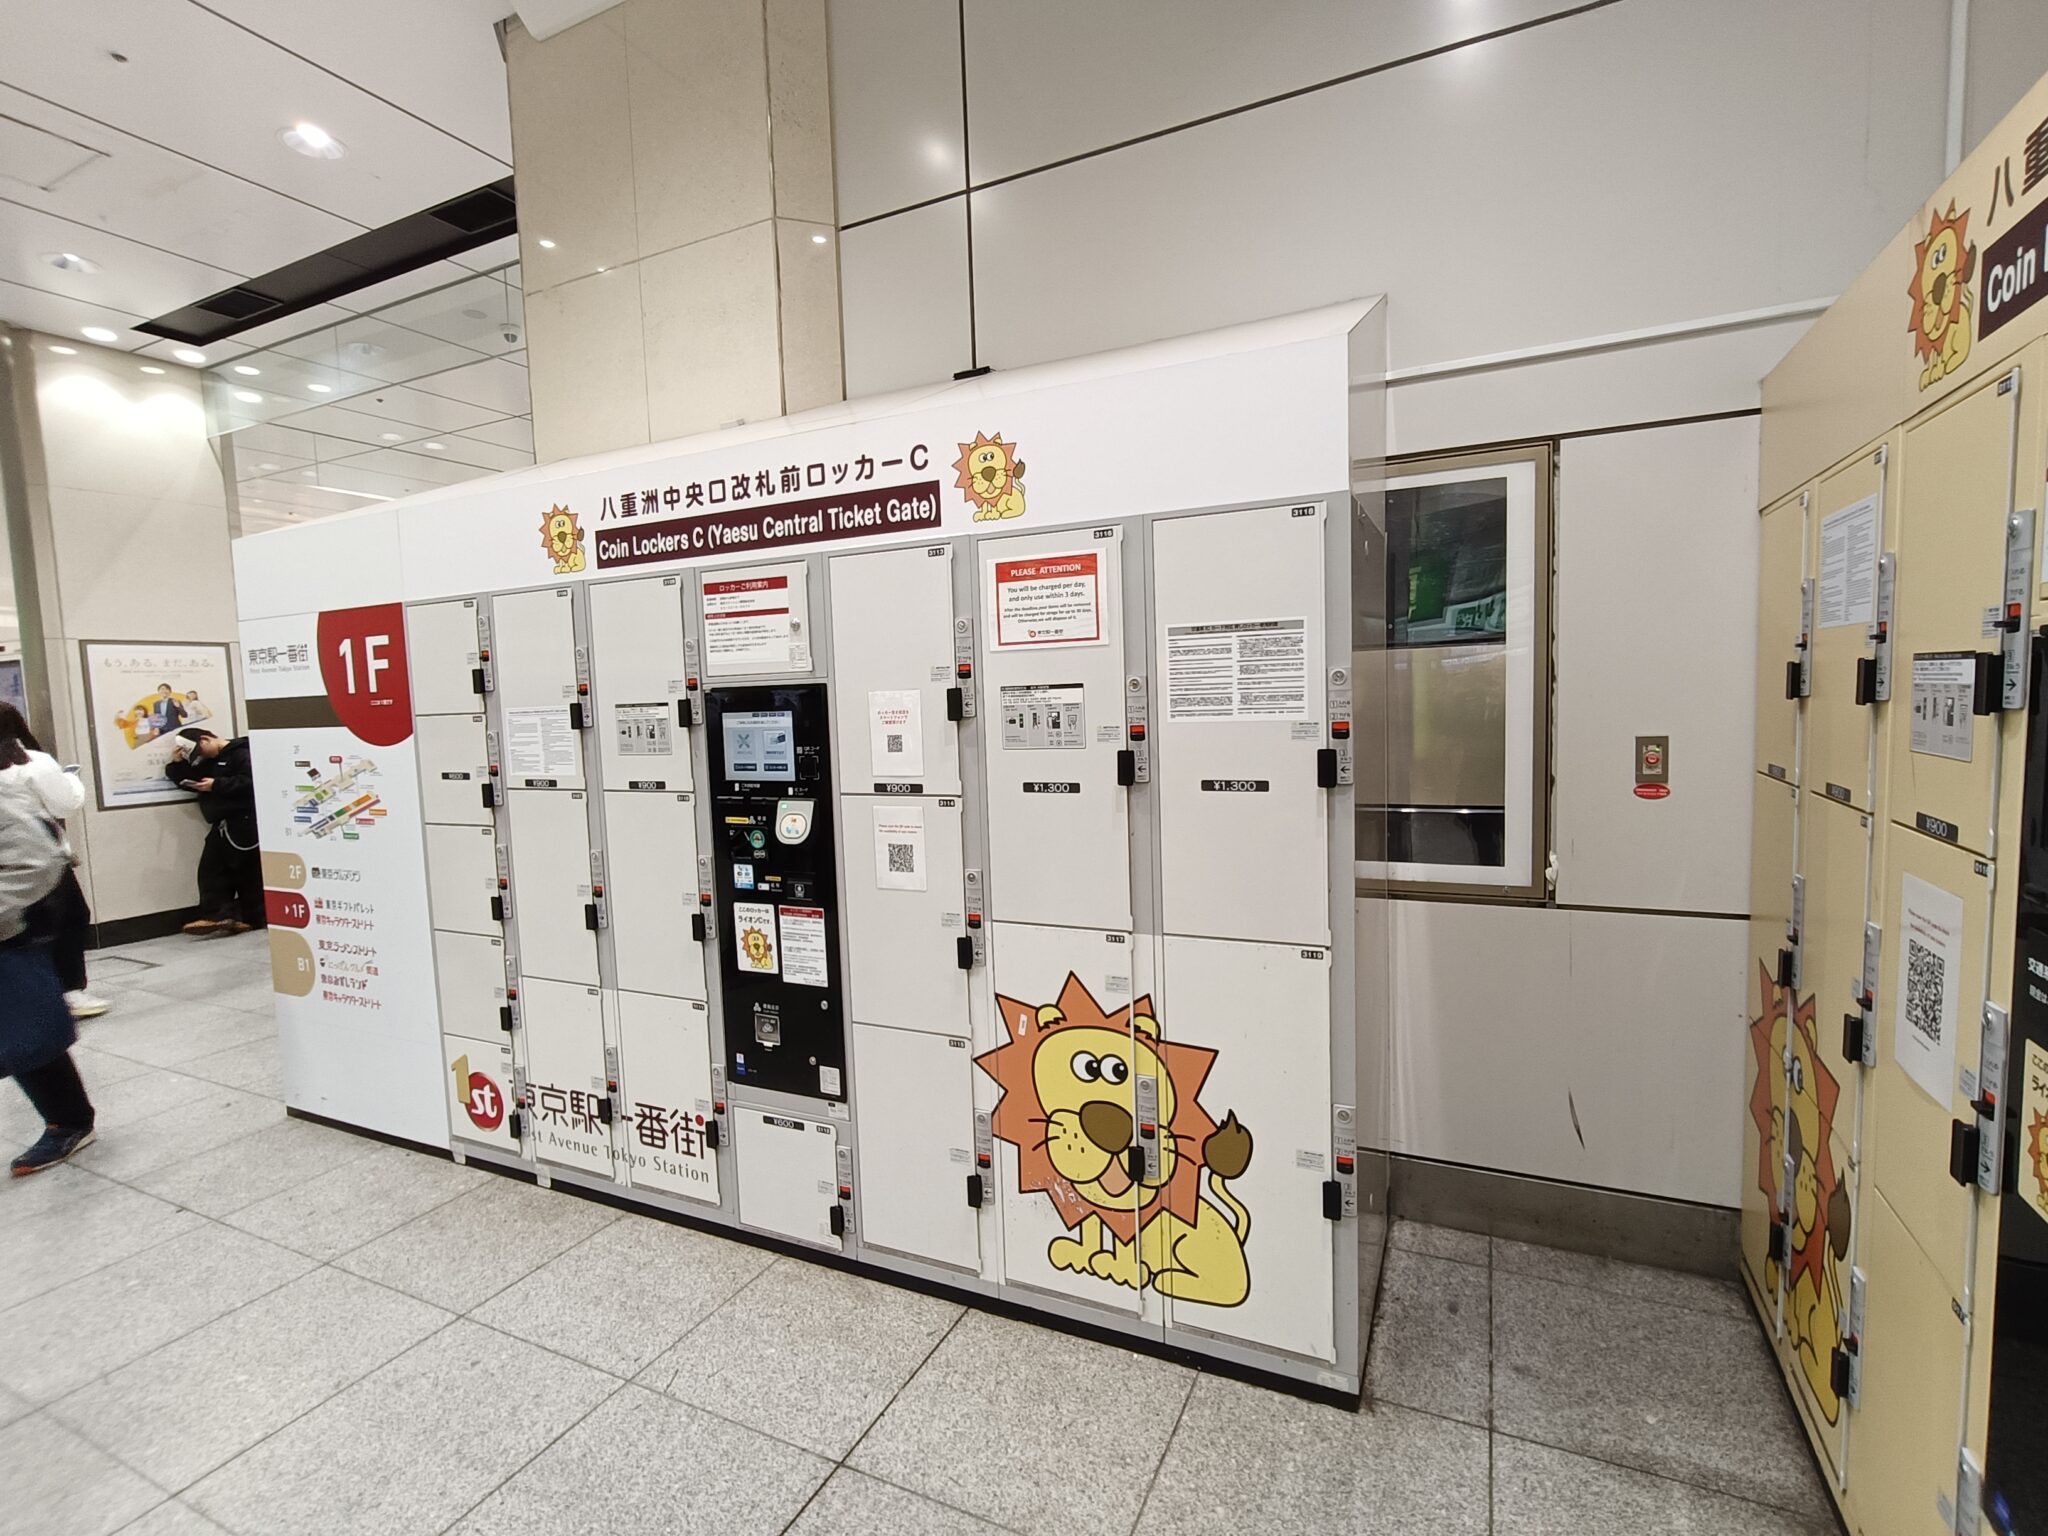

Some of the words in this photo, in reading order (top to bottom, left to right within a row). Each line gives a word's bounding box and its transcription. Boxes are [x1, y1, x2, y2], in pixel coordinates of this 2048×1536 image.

[1987, 246, 2036, 312] Coin
[600, 444, 929, 521] 八重洲中央口改札前ロッカーC
[599, 539, 629, 560] Coin
[632, 532, 689, 556] Lockers
[692, 527, 704, 548] C
[708, 523, 759, 549] (Yaesu
[763, 509, 824, 539] Central
[827, 502, 882, 531] Ticket
[886, 493, 937, 523] Gate)
[1010, 567, 1036, 577] PLEASE
[1039, 563, 1081, 575] ATTENTION
[719, 580, 769, 592] ロッカーご利用案内
[1039, 583, 1061, 591] charged
[338, 634, 390, 694] 1F
[886, 783, 911, 793] ¥900
[1926, 816, 1948, 838] ¥900
[288, 864, 302, 880] 2F
[292, 904, 305, 919] 1F
[297, 957, 310, 973] B1
[2032, 1075, 2048, 1098] ライ
[549, 1131, 597, 1156] Avenue
[604, 1145, 646, 1168] Tokyo
[653, 1156, 709, 1183] Station
